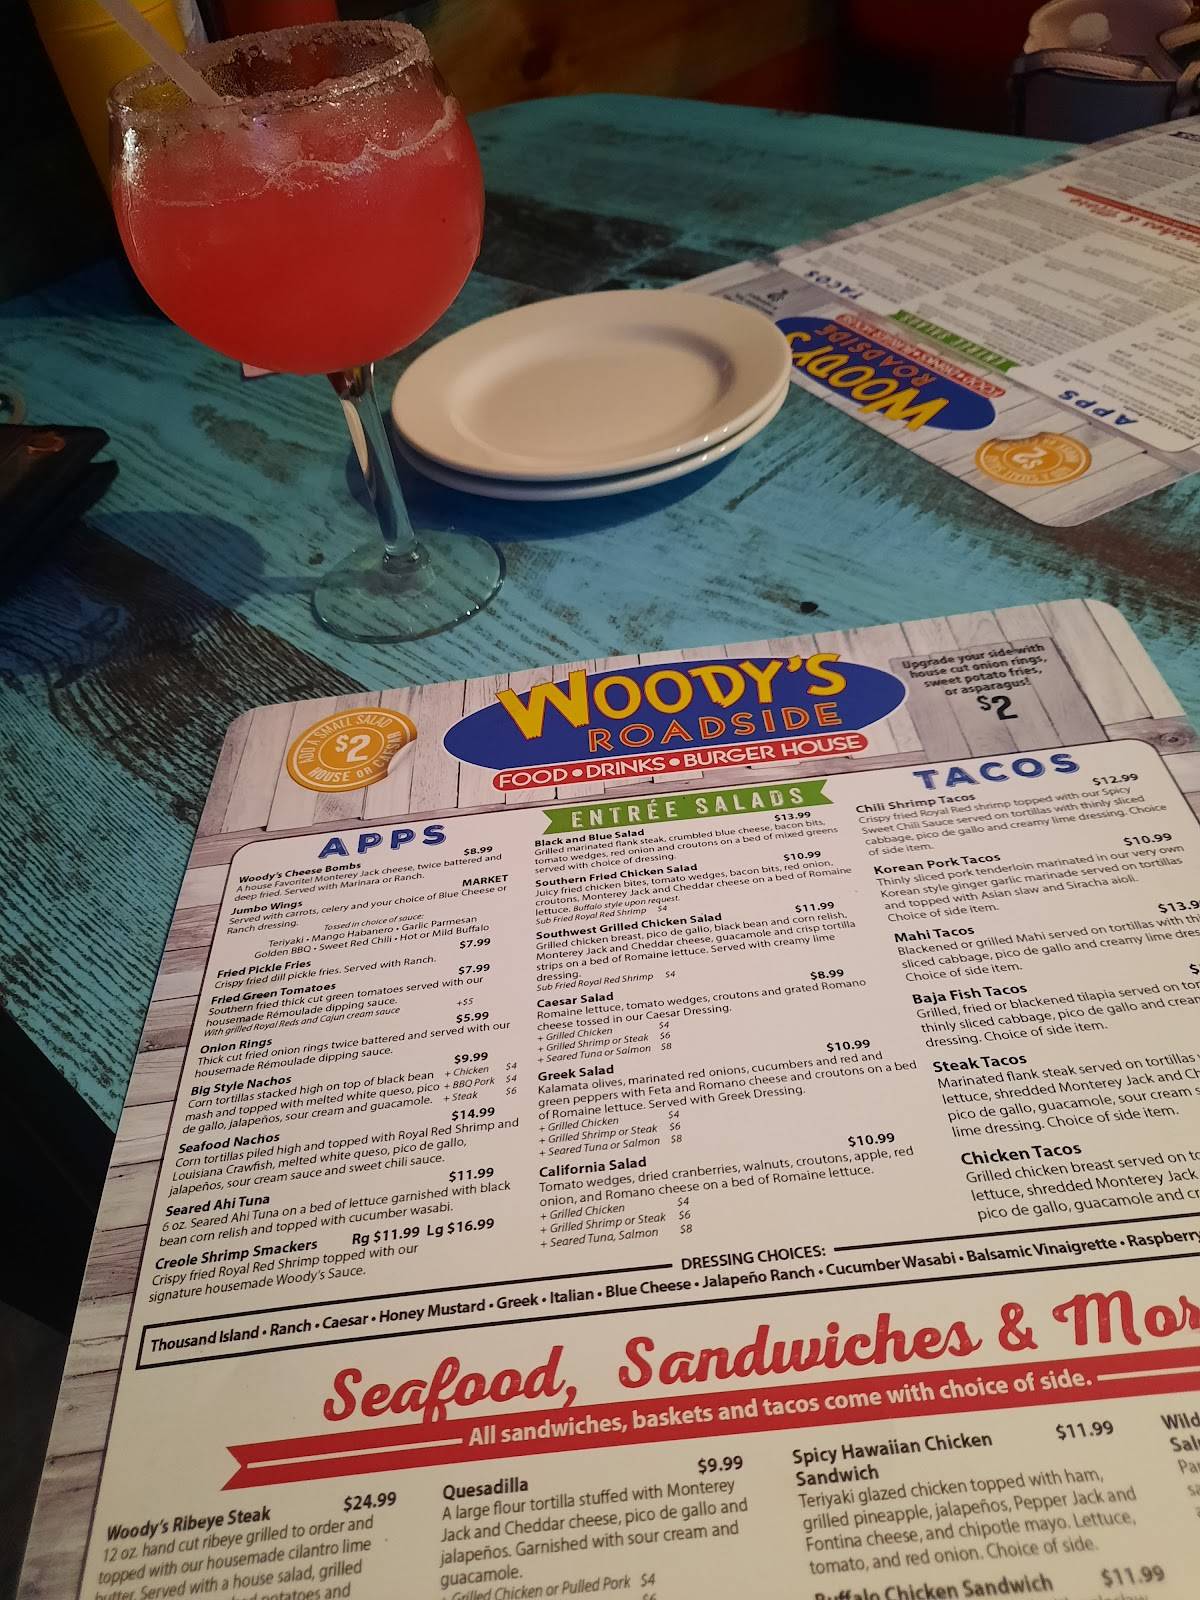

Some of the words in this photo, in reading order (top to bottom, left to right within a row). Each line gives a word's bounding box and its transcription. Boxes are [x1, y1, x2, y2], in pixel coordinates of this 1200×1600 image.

[815, 325, 937, 387] ROADSIDE
[785, 332, 949, 432] WOODY
[1058, 390, 1138, 425] APPS
[902, 656, 955, 669] Upgrade
[958, 652, 985, 664] your
[988, 648, 1012, 658] side
[1013, 643, 1045, 655] with
[909, 667, 947, 679] house
[950, 664, 970, 673] cut
[972, 660, 1008, 671] onion
[1011, 655, 1047, 667] rings,
[924, 676, 961, 688] sweet
[965, 670, 1006, 684] potato
[1008, 666, 1043, 677] fries,
[945, 688, 958, 696] or
[961, 678, 1032, 694] asparagus!
[495, 653, 847, 740] WOODY'S
[976, 695, 1018, 720] $2
[314, 717, 352, 739] SMALL
[355, 714, 392, 728] SALAD
[588, 702, 843, 752] ROADSIDE
[336, 734, 371, 762] $2
[308, 767, 351, 782] HOUSE
[356, 766, 373, 778] OR
[499, 768, 568, 788] FOOD
[586, 756, 666, 778] DRINKS
[684, 745, 776, 768] BURGER
[780, 735, 862, 756] HOUSE
[913, 753, 1080, 790] TACOS
[571, 799, 678, 828] ENTRÉE
[696, 788, 804, 815] SALADS
[319, 824, 447, 859] APPS
[463, 845, 493, 856] $8.99
[1123, 832, 1172, 846] $10.99
[783, 850, 821, 861] $10.99
[873, 863, 924, 874] Korean
[926, 857, 960, 868] Pork
[959, 854, 1001, 864] Tacos
[239, 871, 282, 883] Woody's
[284, 868, 322, 877] Cheese
[324, 862, 361, 872] Bombs
[462, 874, 508, 887] MARKET
[535, 876, 586, 887] Southern
[589, 871, 617, 881] Fried
[619, 868, 663, 878] Chicken
[666, 863, 698, 873] Salad
[230, 904, 268, 915] Jumbo
[270, 901, 302, 910] Wings
[268, 936, 304, 947] Teriyaki
[311, 932, 345, 942] Mango
[347, 927, 394, 937] Habanero
[401, 921, 428, 931] Garlic
[430, 916, 477, 927] Parmesan
[810, 968, 844, 981] $8.99
[536, 997, 577, 1008] Caesar
[580, 991, 613, 1003] Salad
[911, 991, 947, 1005] Baja
[949, 987, 982, 1000] Fish
[982, 985, 1027, 996] Tacos
[205, 1012, 264, 1027] housemade
[266, 1005, 323, 1019] Rémoulade
[325, 1001, 364, 1013] dipping
[367, 998, 397, 1007] sauce.
[537, 1021, 573, 1031] cheese
[576, 1015, 610, 1027] tossed
[612, 1014, 622, 1023] in
[625, 1013, 643, 1022] our
[645, 1010, 680, 1019] Caesar
[683, 1004, 731, 1016] Dressing.
[932, 1057, 980, 1072] Steak
[979, 1055, 1027, 1067] Tacos
[951, 1126, 981, 1137] lime
[984, 1119, 1045, 1134] dressing.
[1046, 1114, 1093, 1127] Choice
[1096, 1110, 1110, 1122] of
[1113, 1108, 1141, 1121] side
[1142, 1107, 1179, 1117] item.
[847, 1132, 894, 1148] $10.99
[539, 1161, 605, 1177] California
[609, 1156, 646, 1170] Salad
[960, 1148, 1030, 1165] Chicken
[1030, 1144, 1082, 1158] Tacos
[448, 1167, 494, 1183] $11.99
[165, 1200, 211, 1217] Seared
[213, 1197, 236, 1210] Ahi
[238, 1195, 270, 1207] Tuna
[351, 1232, 370, 1246] Rg
[373, 1226, 420, 1243] $11.99
[426, 1224, 443, 1238] Lg
[447, 1217, 494, 1234] $16.99
[155, 1253, 198, 1270] Creole
[200, 1249, 249, 1264] Shrimp
[252, 1240, 317, 1257] Smackers
[681, 1252, 754, 1271] DRESSING
[758, 1245, 826, 1263] CHOICES:
[151, 1330, 217, 1352] Thousand
[219, 1324, 260, 1343] Island
[269, 1318, 311, 1336] Ranch
[322, 1315, 369, 1329] Caesar
[379, 1308, 425, 1323] Honey
[427, 1298, 485, 1317] Mustard
[496, 1292, 539, 1309] Greek
[550, 1288, 594, 1304] Italian
[605, 1284, 637, 1298] Blue
[639, 1280, 691, 1294] Cheese
[702, 1271, 767, 1288] Jalapeño
[769, 1265, 815, 1281] Ranch
[827, 1257, 901, 1276] Cucumber
[902, 1253, 956, 1268] Wasabi
[967, 1244, 1032, 1262] Balsamic
[1034, 1238, 1116, 1256] Vinaigrette
[323, 1345, 578, 1423] Seafood,
[619, 1313, 981, 1388] Sandwiches
[999, 1302, 1038, 1352] &
[1052, 1290, 1200, 1345] Mor
[469, 1426, 496, 1447] All
[501, 1414, 627, 1443] sandwiches,
[632, 1402, 714, 1430] baskets
[719, 1398, 759, 1421] and
[763, 1395, 819, 1417] tacos
[825, 1389, 882, 1411] come
[887, 1380, 934, 1404] with
[939, 1374, 1009, 1398] choice
[1014, 1372, 1036, 1392] of
[1041, 1368, 1093, 1390] side.
[1055, 1420, 1114, 1441] $11.99
[792, 1447, 837, 1467] Spicy
[841, 1438, 921, 1459] Hawaiian
[924, 1432, 992, 1451] Chicken
[697, 1455, 743, 1475] $9.99
[795, 1463, 879, 1486] Sandwich
[442, 1476, 528, 1501] Quesadilla
[343, 1491, 396, 1512] $24.99
[107, 1518, 168, 1542] Woody's
[172, 1514, 224, 1532] Ribeye
[227, 1505, 271, 1525] Steak
[440, 1525, 471, 1542] Jack
[473, 1521, 501, 1539] and
[504, 1516, 565, 1535] Cheddar
[568, 1513, 621, 1529] cheese,
[624, 1508, 656, 1527] pico
[659, 1504, 677, 1520] de
[681, 1500, 717, 1521] gallo
[720, 1496, 748, 1514] and
